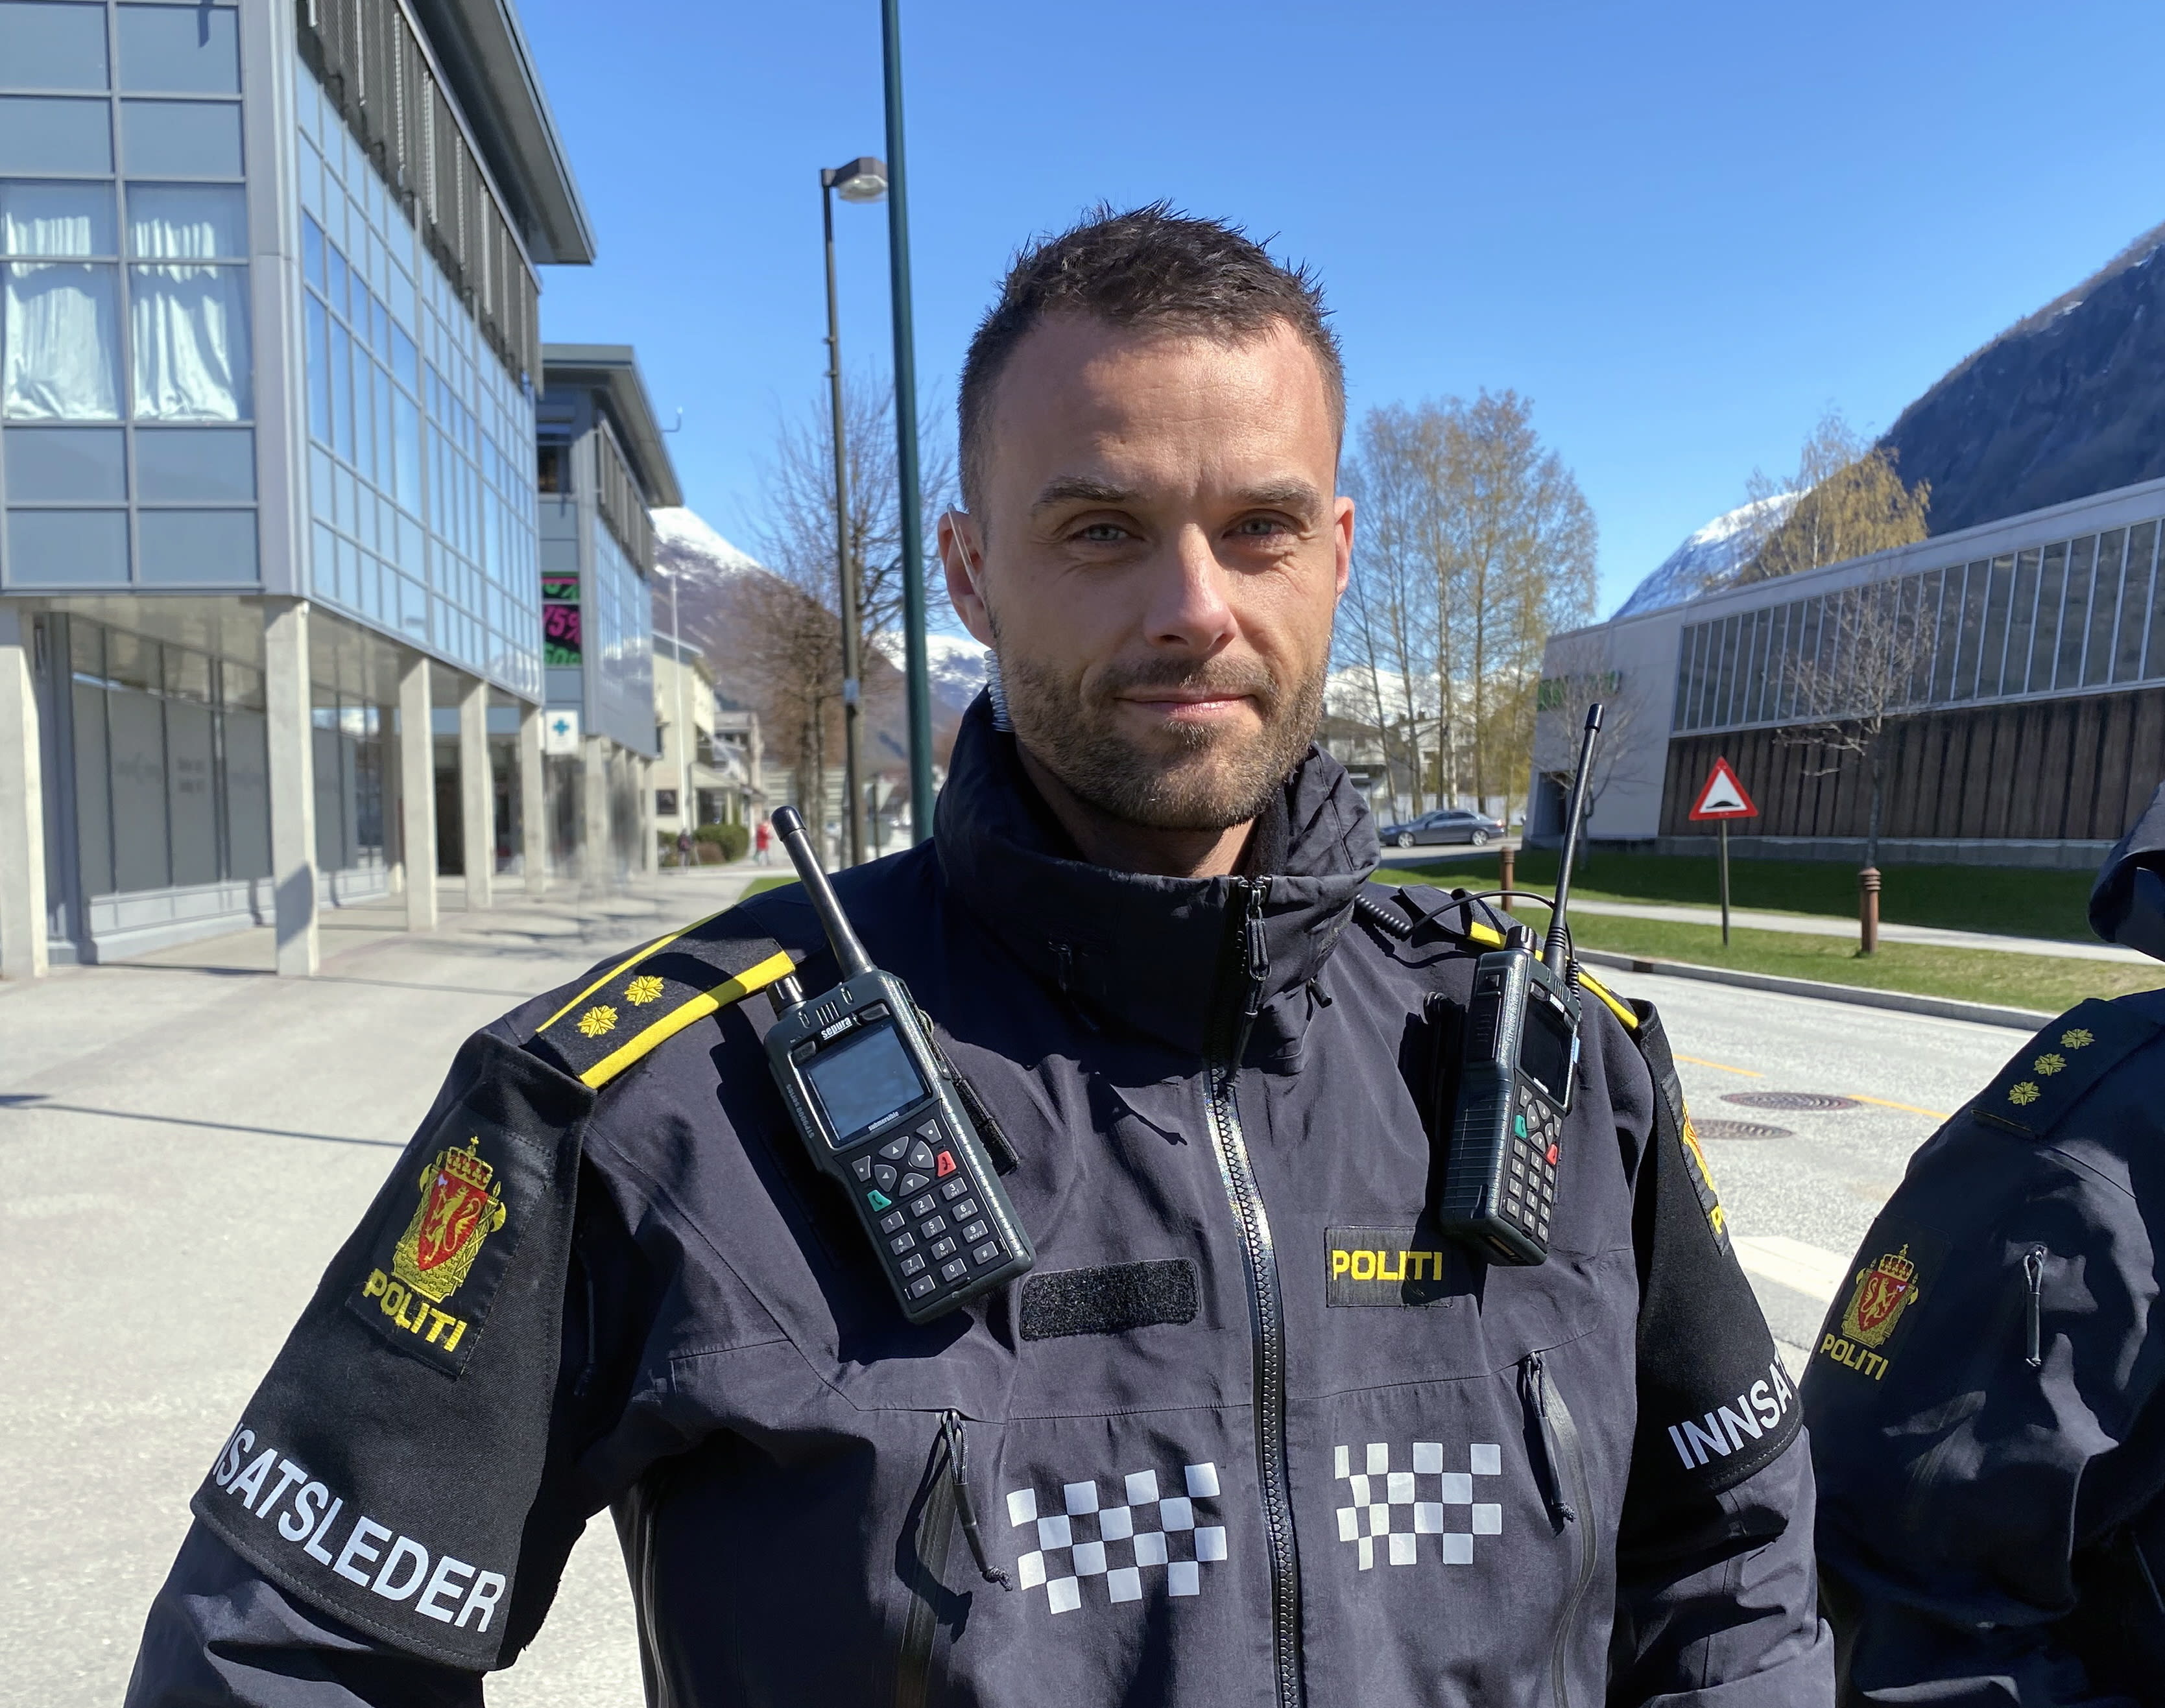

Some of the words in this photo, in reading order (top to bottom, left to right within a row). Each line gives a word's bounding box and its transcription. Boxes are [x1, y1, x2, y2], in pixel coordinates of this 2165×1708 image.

[821, 1017, 852, 1040] sepura
[918, 1200, 925, 1209] 2
[1710, 1205, 1723, 1235] P
[1332, 1250, 1443, 1281] POLITI
[362, 1268, 468, 1353] POLITI
[1819, 1333, 1889, 1381] POLITI
[1668, 1344, 1793, 1470] INNSA
[212, 1422, 507, 1633] SATSLEDER
